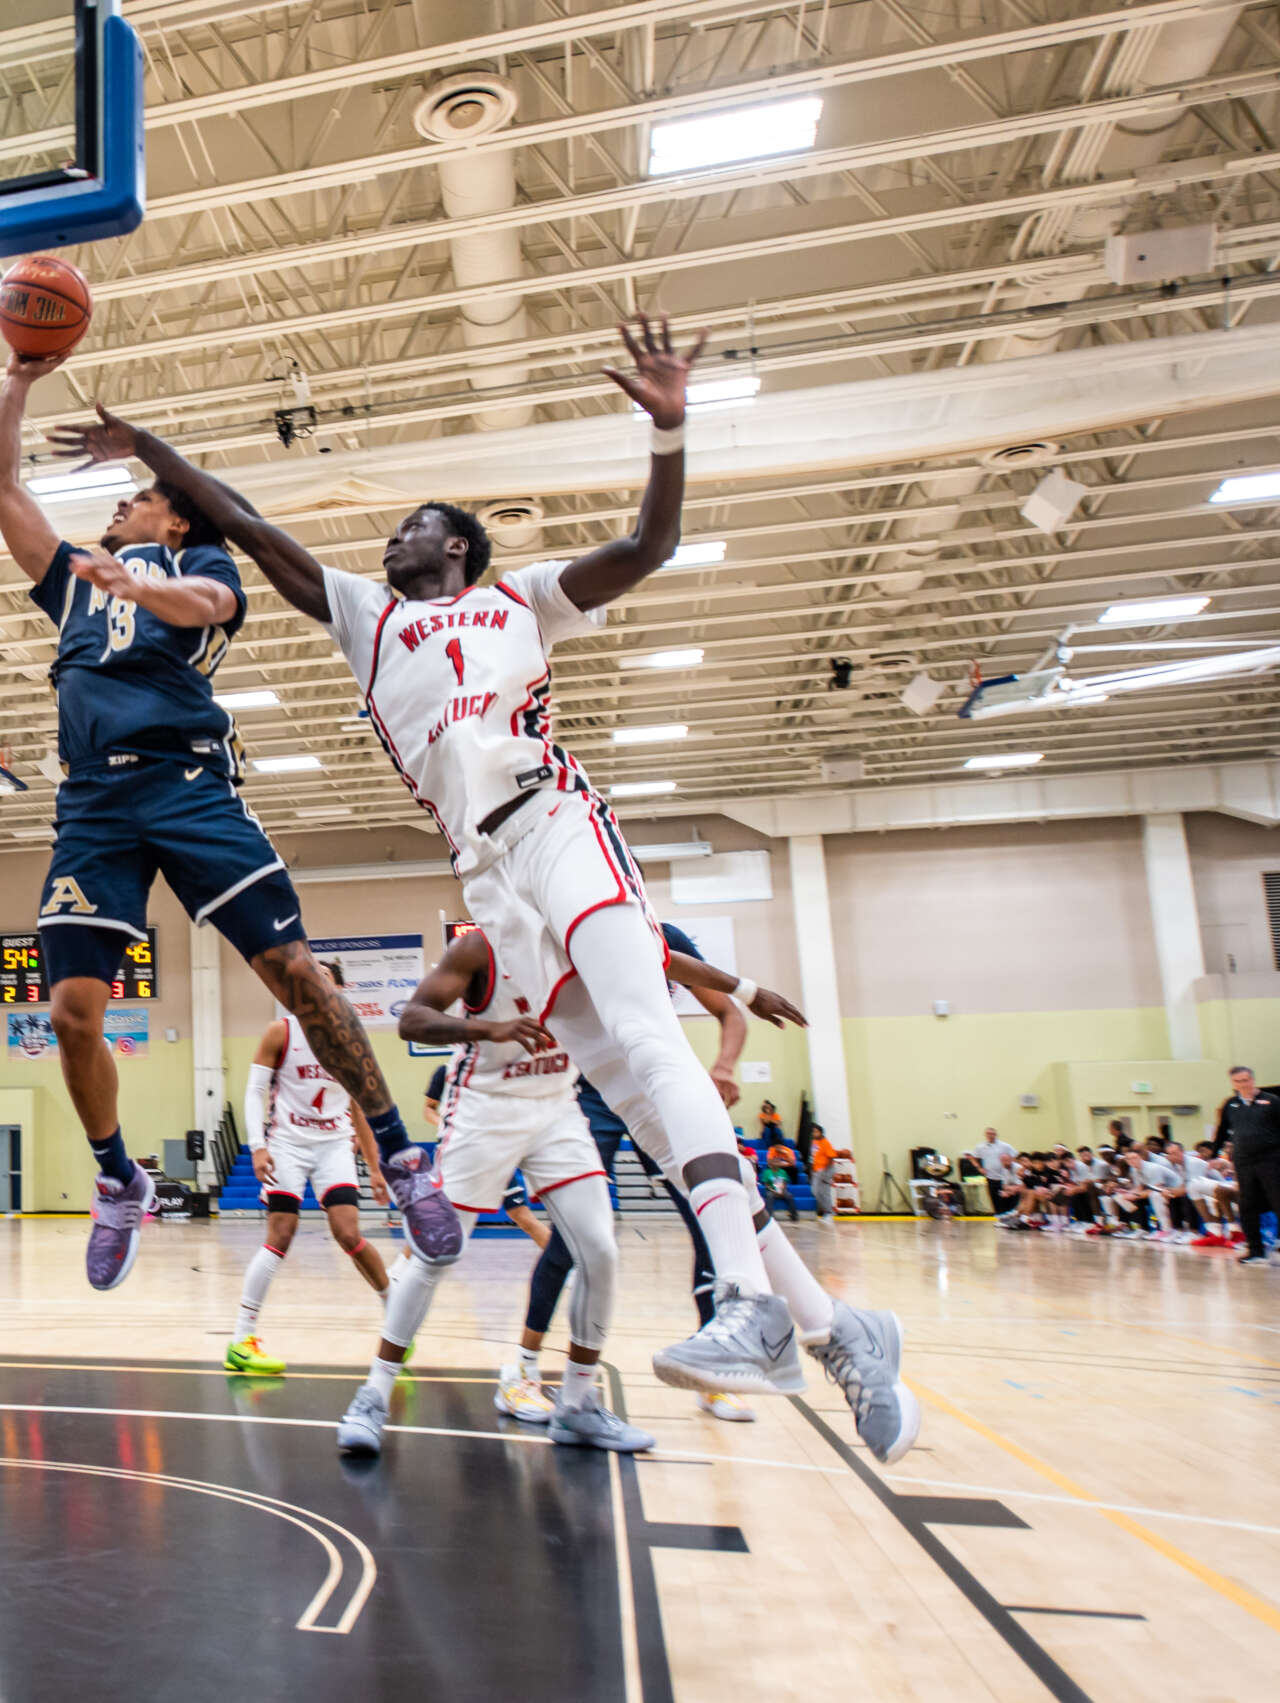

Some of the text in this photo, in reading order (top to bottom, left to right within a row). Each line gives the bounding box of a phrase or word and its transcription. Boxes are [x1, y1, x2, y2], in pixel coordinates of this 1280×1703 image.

[398, 609, 508, 653] WESTERN
[445, 638, 464, 687] 1
[41, 876, 99, 916] A
[3, 948, 29, 969] 54
[3, 986, 17, 1002] 2
[27, 985, 40, 1002] 3
[111, 981, 125, 998] 3
[137, 981, 151, 997] 6
[312, 1087, 326, 1115] 4
